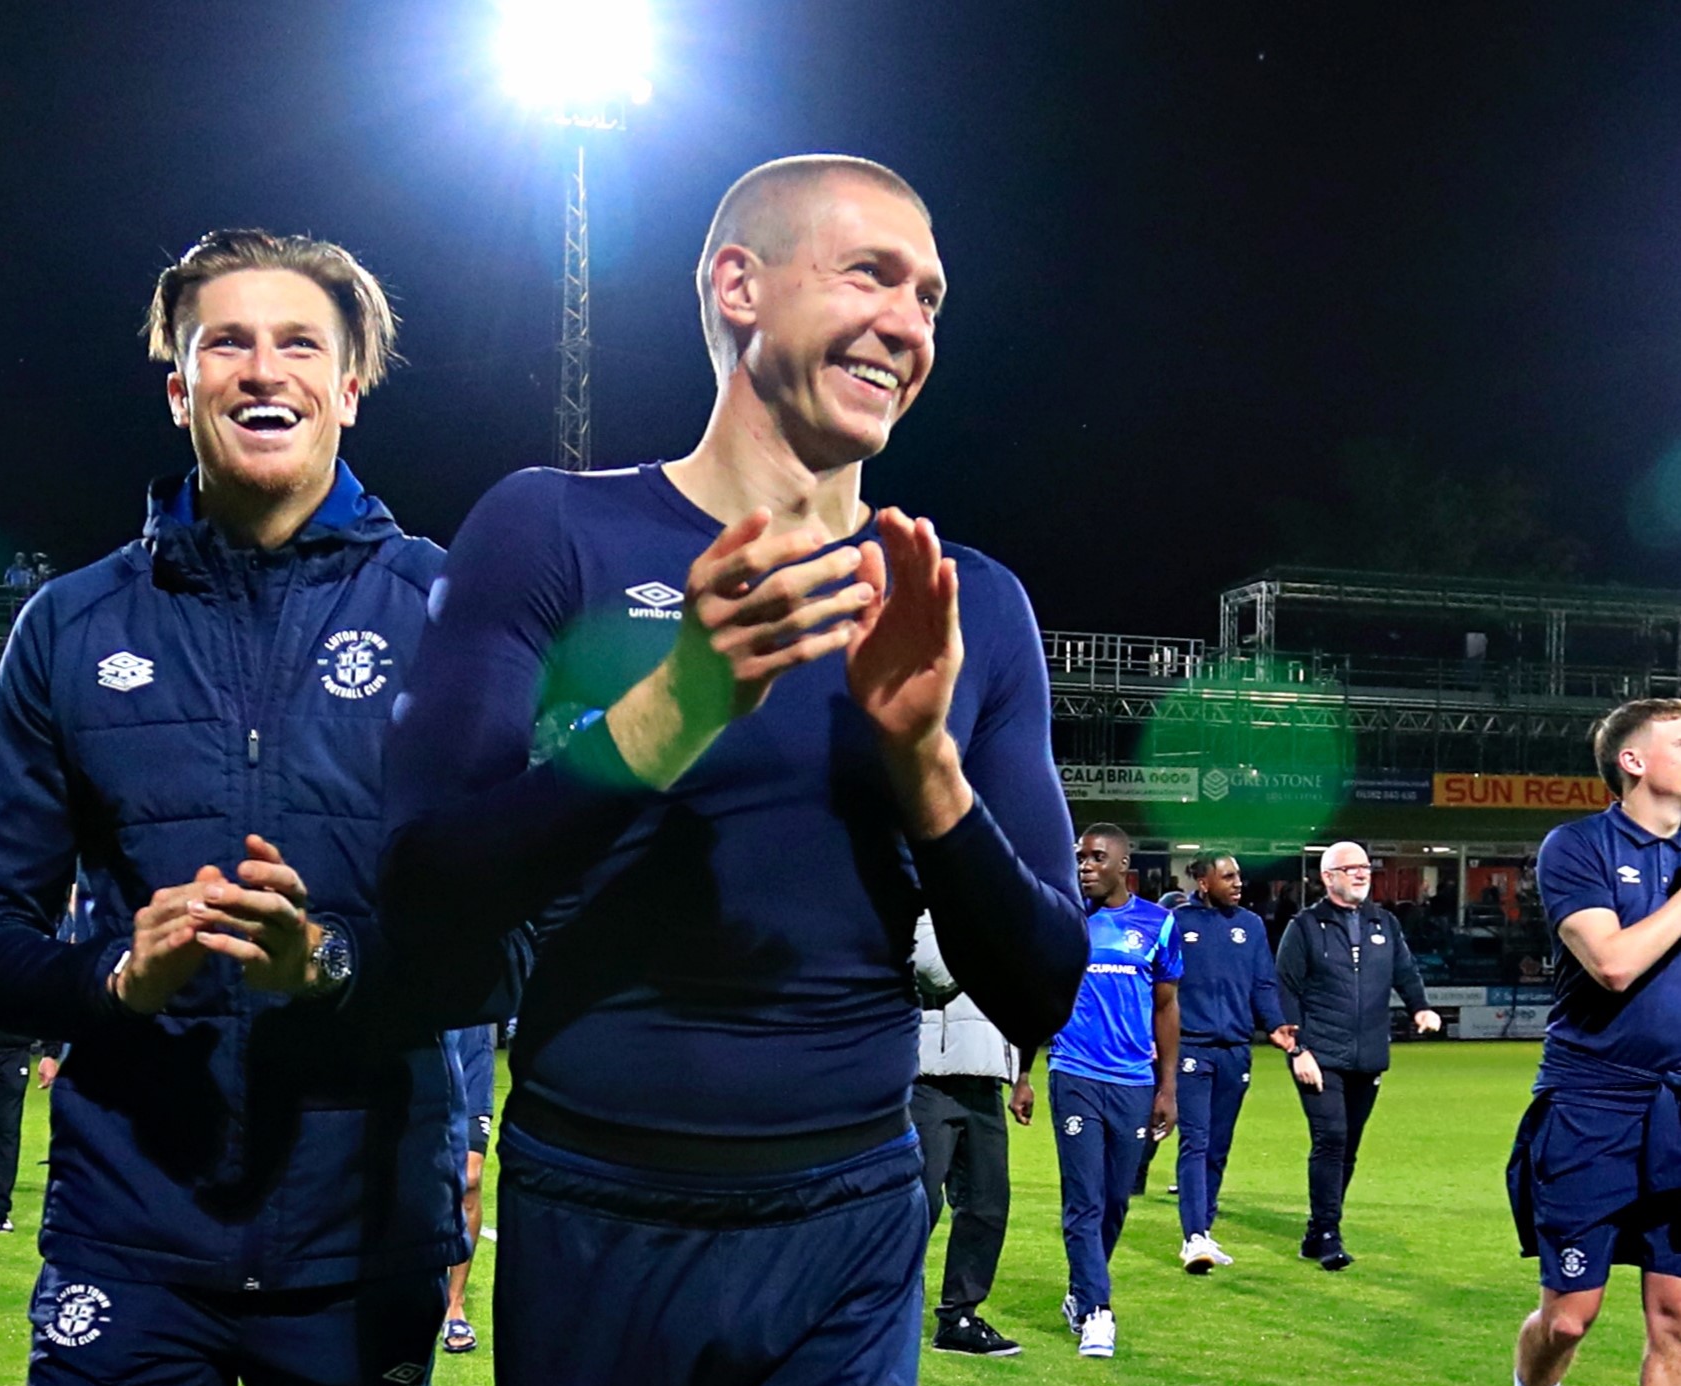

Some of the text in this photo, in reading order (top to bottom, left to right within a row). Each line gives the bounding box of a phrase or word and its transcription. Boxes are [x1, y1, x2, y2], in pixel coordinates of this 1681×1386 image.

[628, 607, 682, 620] umbro
[324, 630, 388, 651] LUTON TOWN
[321, 674, 387, 699] FOOTBALL CLUB
[1061, 767, 1146, 783] CALABRIA
[1230, 772, 1323, 788] GREYSTONE
[1445, 777, 1513, 803] SUN
[56, 1284, 111, 1309] LUTON TOWN
